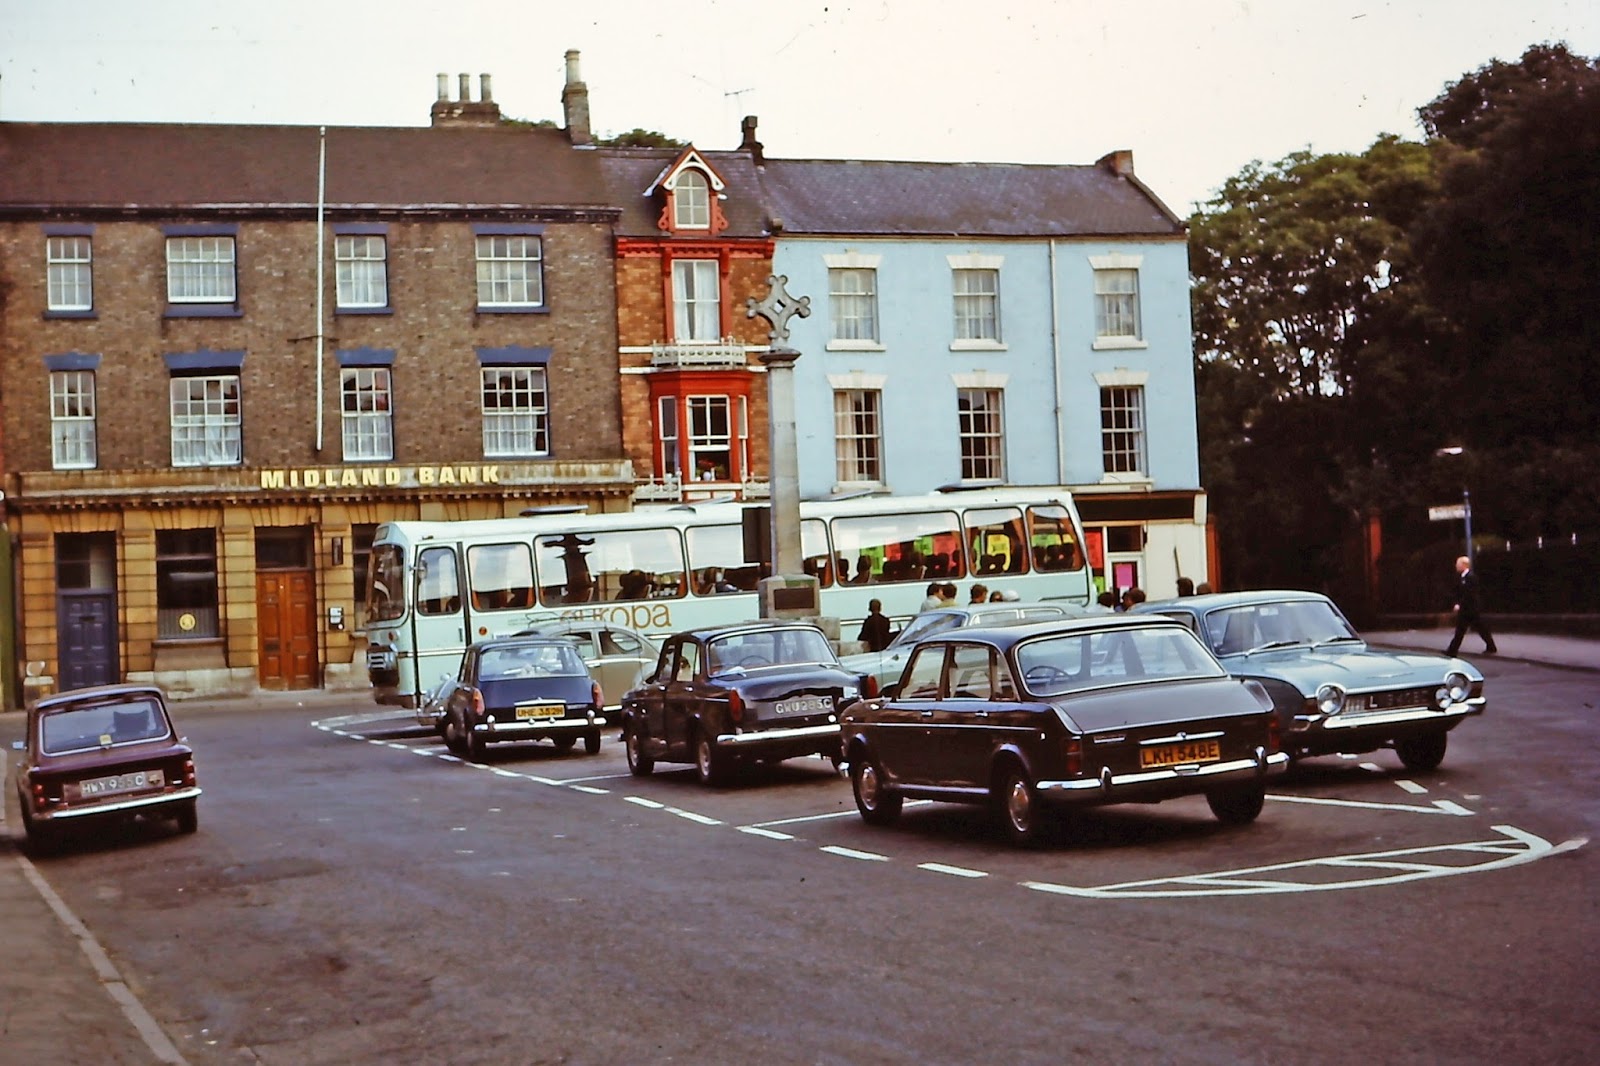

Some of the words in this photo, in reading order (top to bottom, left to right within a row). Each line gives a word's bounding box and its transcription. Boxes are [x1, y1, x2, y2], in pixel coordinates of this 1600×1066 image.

[260, 467, 401, 489] MIDLAND
[418, 465, 499, 484] BANK
[1142, 747, 1174, 766] LKH
